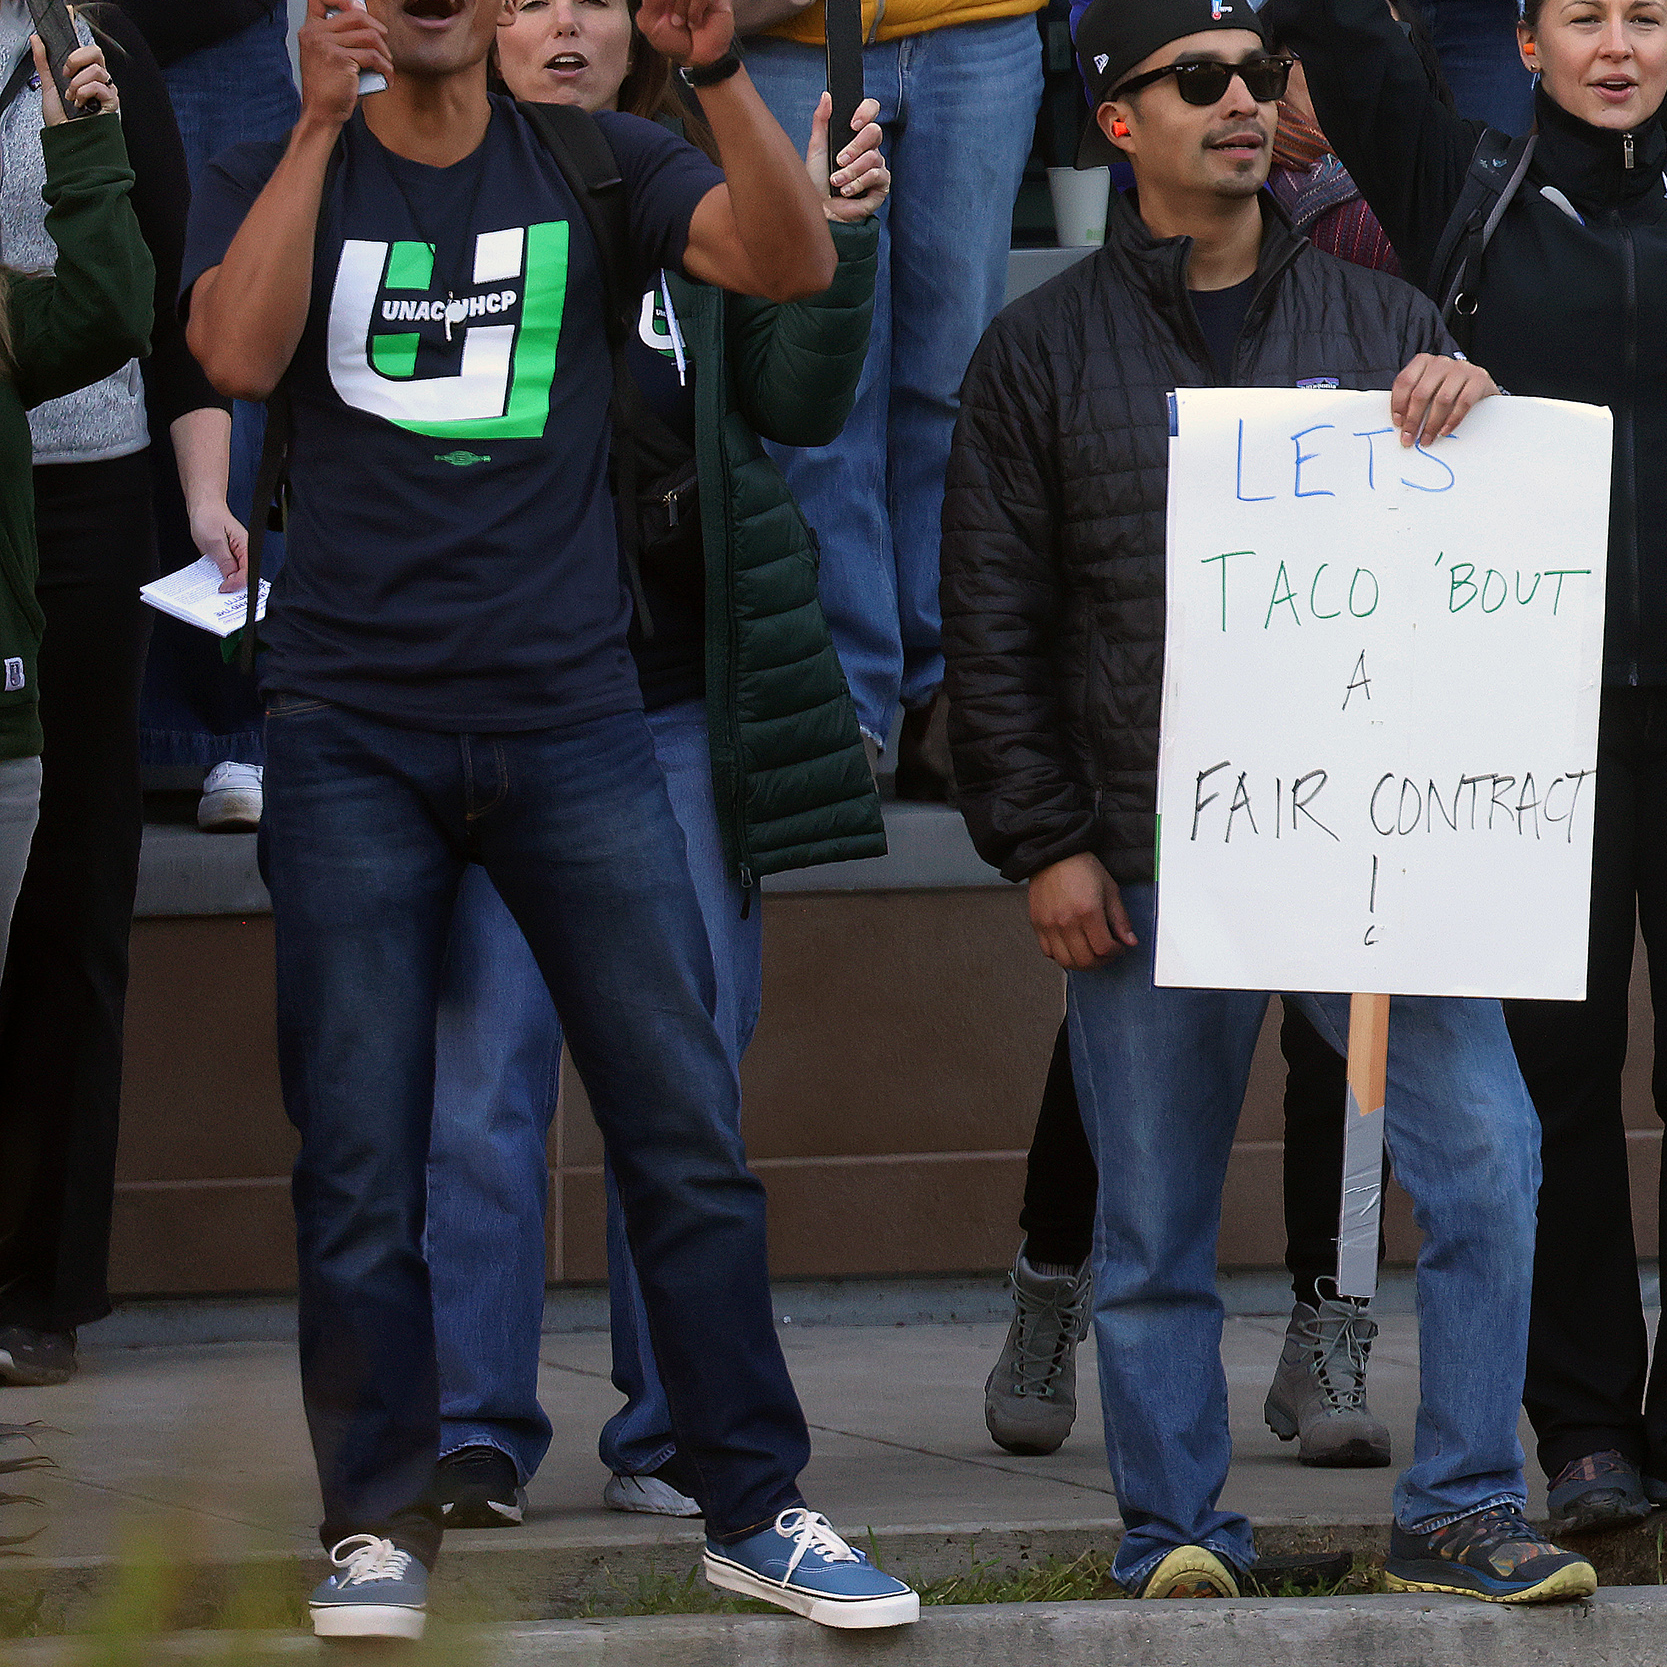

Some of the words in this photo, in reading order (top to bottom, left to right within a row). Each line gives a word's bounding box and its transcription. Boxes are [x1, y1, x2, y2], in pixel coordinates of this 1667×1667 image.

[1201, 551, 1379, 632] TACO
[1434, 552, 1592, 616] 'BOUT
[1342, 650, 1371, 709] A
[1191, 761, 1340, 843] FAIR
[1369, 769, 1595, 843] CONTRACT
